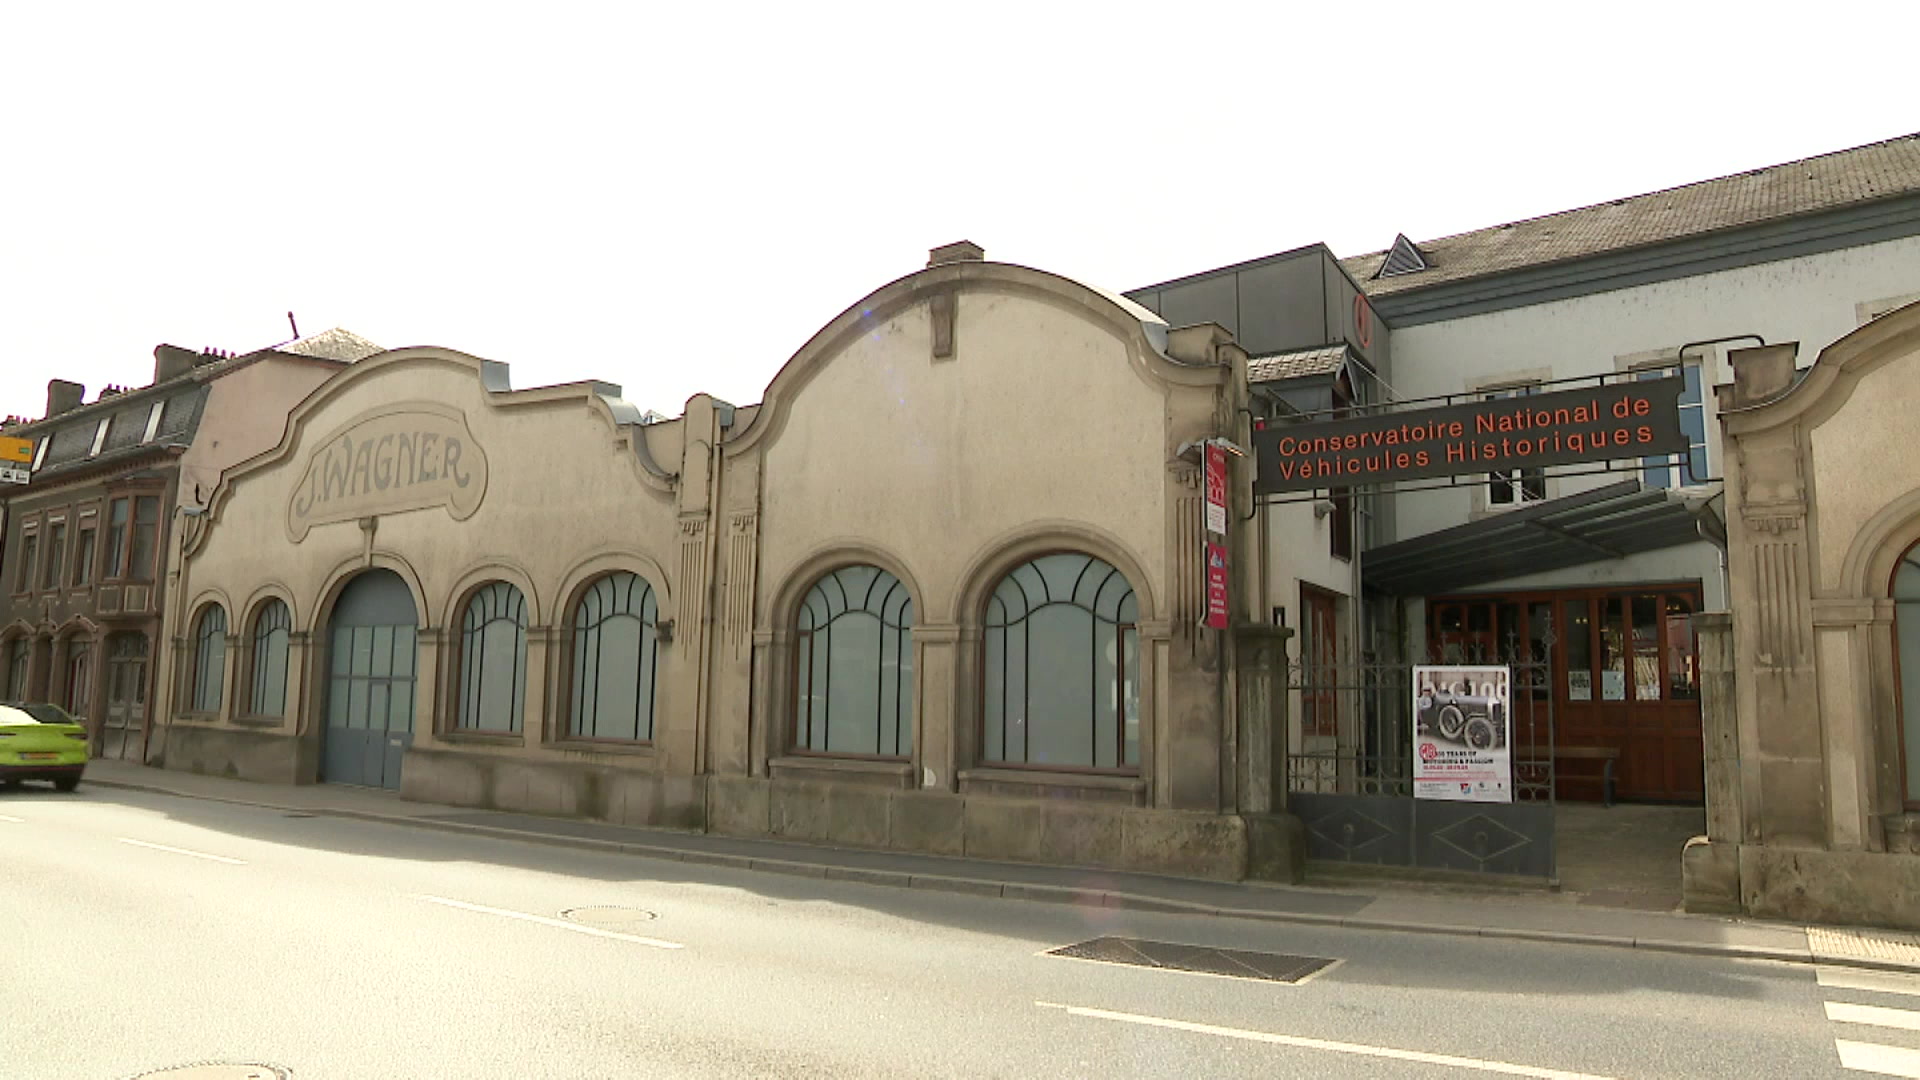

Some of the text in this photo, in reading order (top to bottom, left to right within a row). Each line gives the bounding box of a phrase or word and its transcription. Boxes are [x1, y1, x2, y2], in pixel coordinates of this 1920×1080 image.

[1279, 396, 1651, 457] Conservatoire National de
[1279, 425, 1654, 481] Véhicules Historiques
